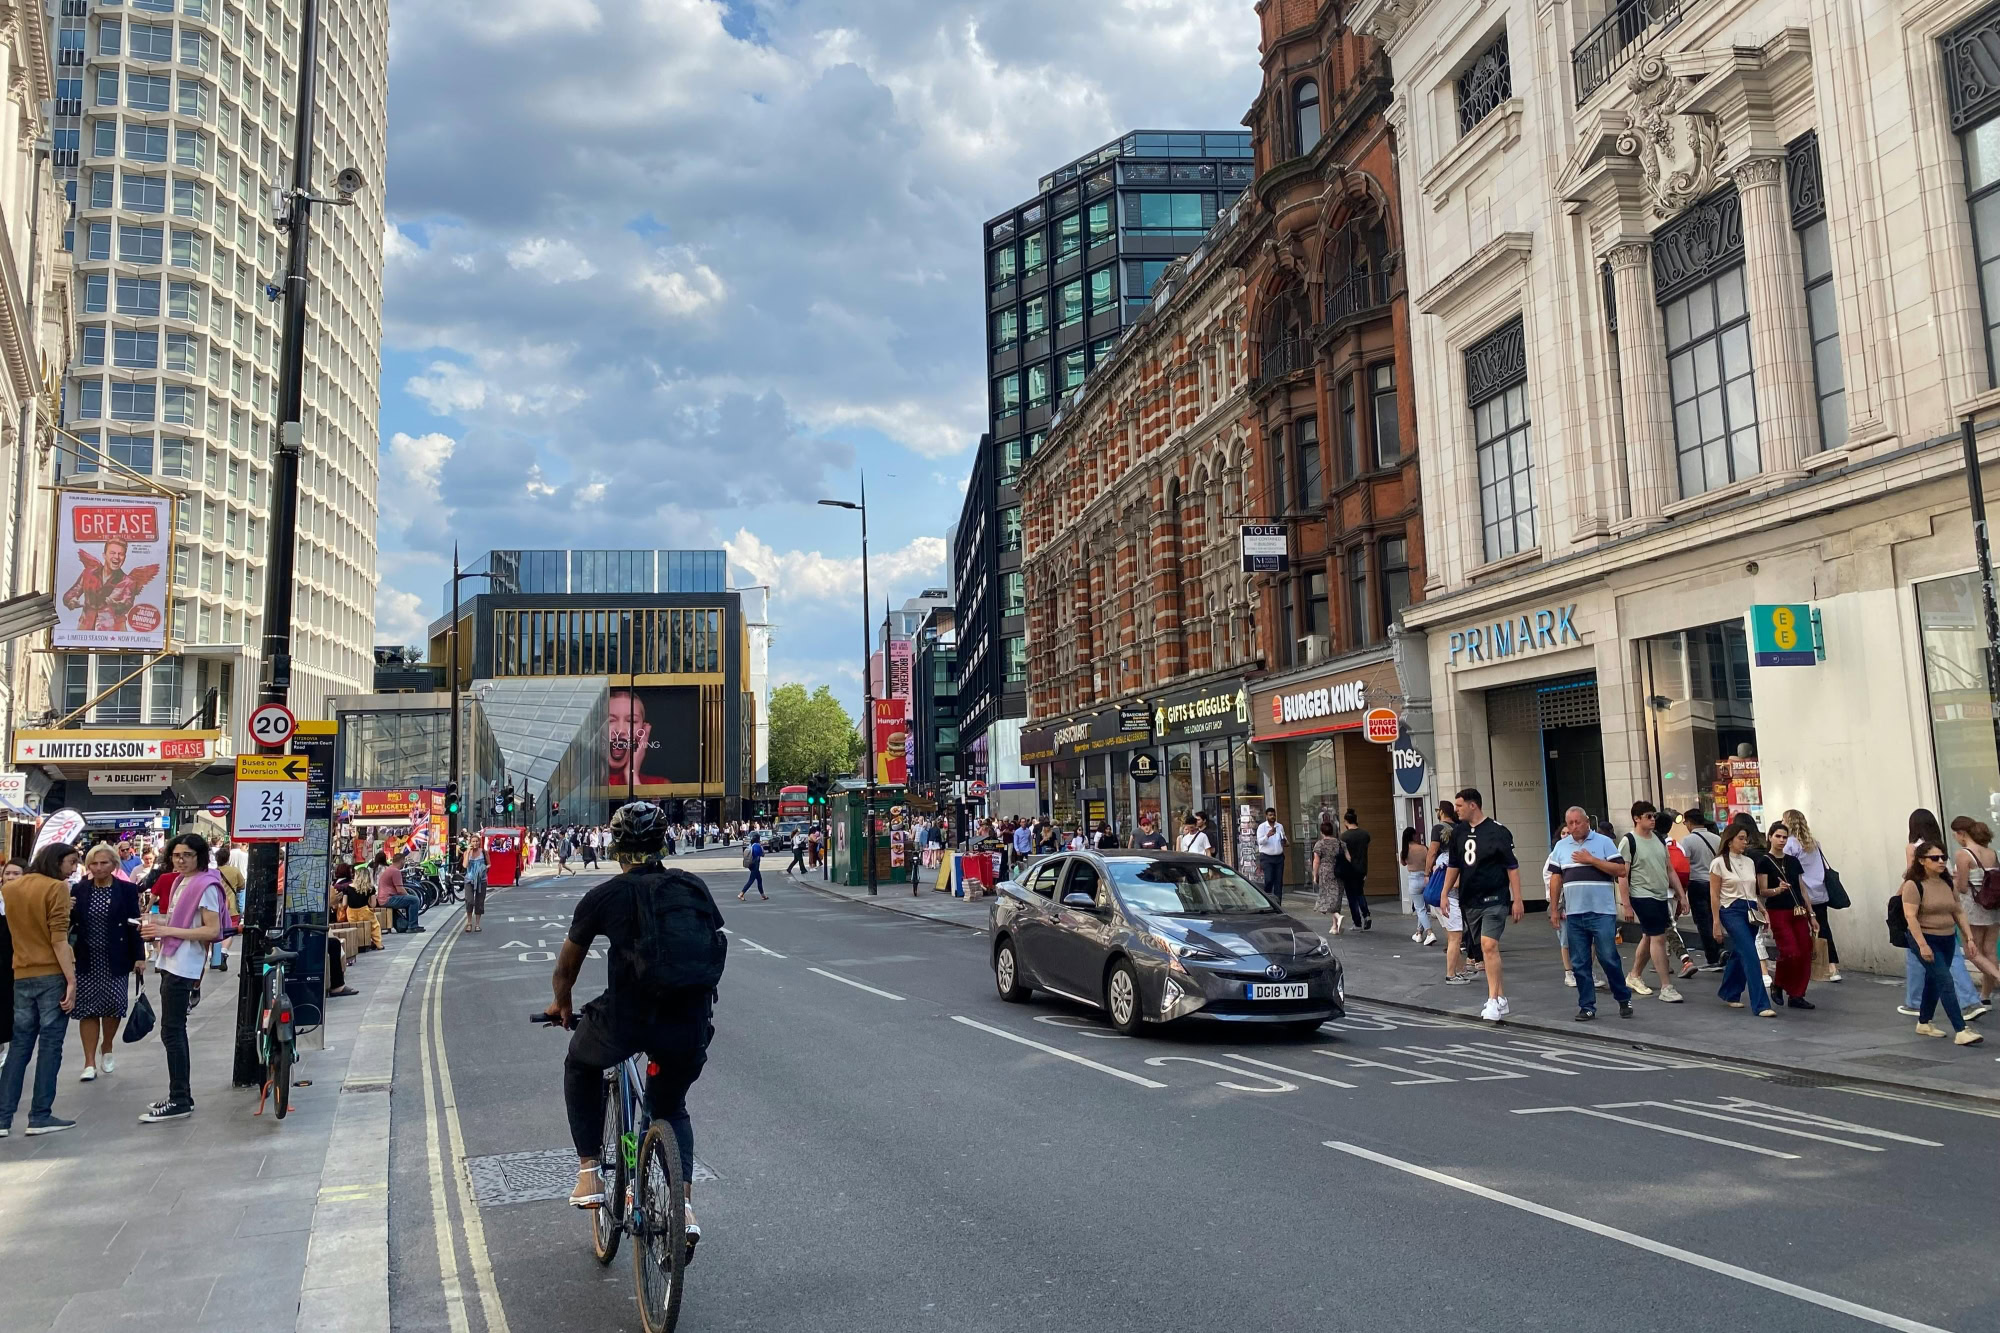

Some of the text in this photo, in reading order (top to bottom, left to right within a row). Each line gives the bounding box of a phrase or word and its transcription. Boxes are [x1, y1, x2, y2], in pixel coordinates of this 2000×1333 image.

[81, 514, 153, 534] GREASE
[1249, 526, 1280, 535] TO LET
[137, 609, 155, 618] JASON
[67, 633, 88, 641] LIMITED
[88, 634, 109, 642] SEASON
[1450, 603, 1581, 667] PRIMARK
[890, 660, 900, 693] MOUNTAIN
[900, 657, 910, 696] BROKEBACK
[1167, 693, 1232, 724] GIFTS & GIGGLES
[1283, 680, 1365, 722] BURGER KING
[256, 716, 290, 734] 20
[877, 718, 904, 726] Hungry?
[1190, 723, 1205, 734] LONDON
[1204, 722, 1213, 732] GIFT
[1212, 720, 1223, 730] SHOP
[1369, 719, 1397, 727] BURGER
[1369, 726, 1398, 735] KING
[39, 742, 202, 758] LIMITED SEASON GREASE
[261, 790, 284, 806] 24
[260, 806, 283, 822] 29
[1464, 838, 1477, 866] 8
[1256, 984, 1304, 998] DG18 YYD
[1509, 1095, 1944, 1160] ALL
